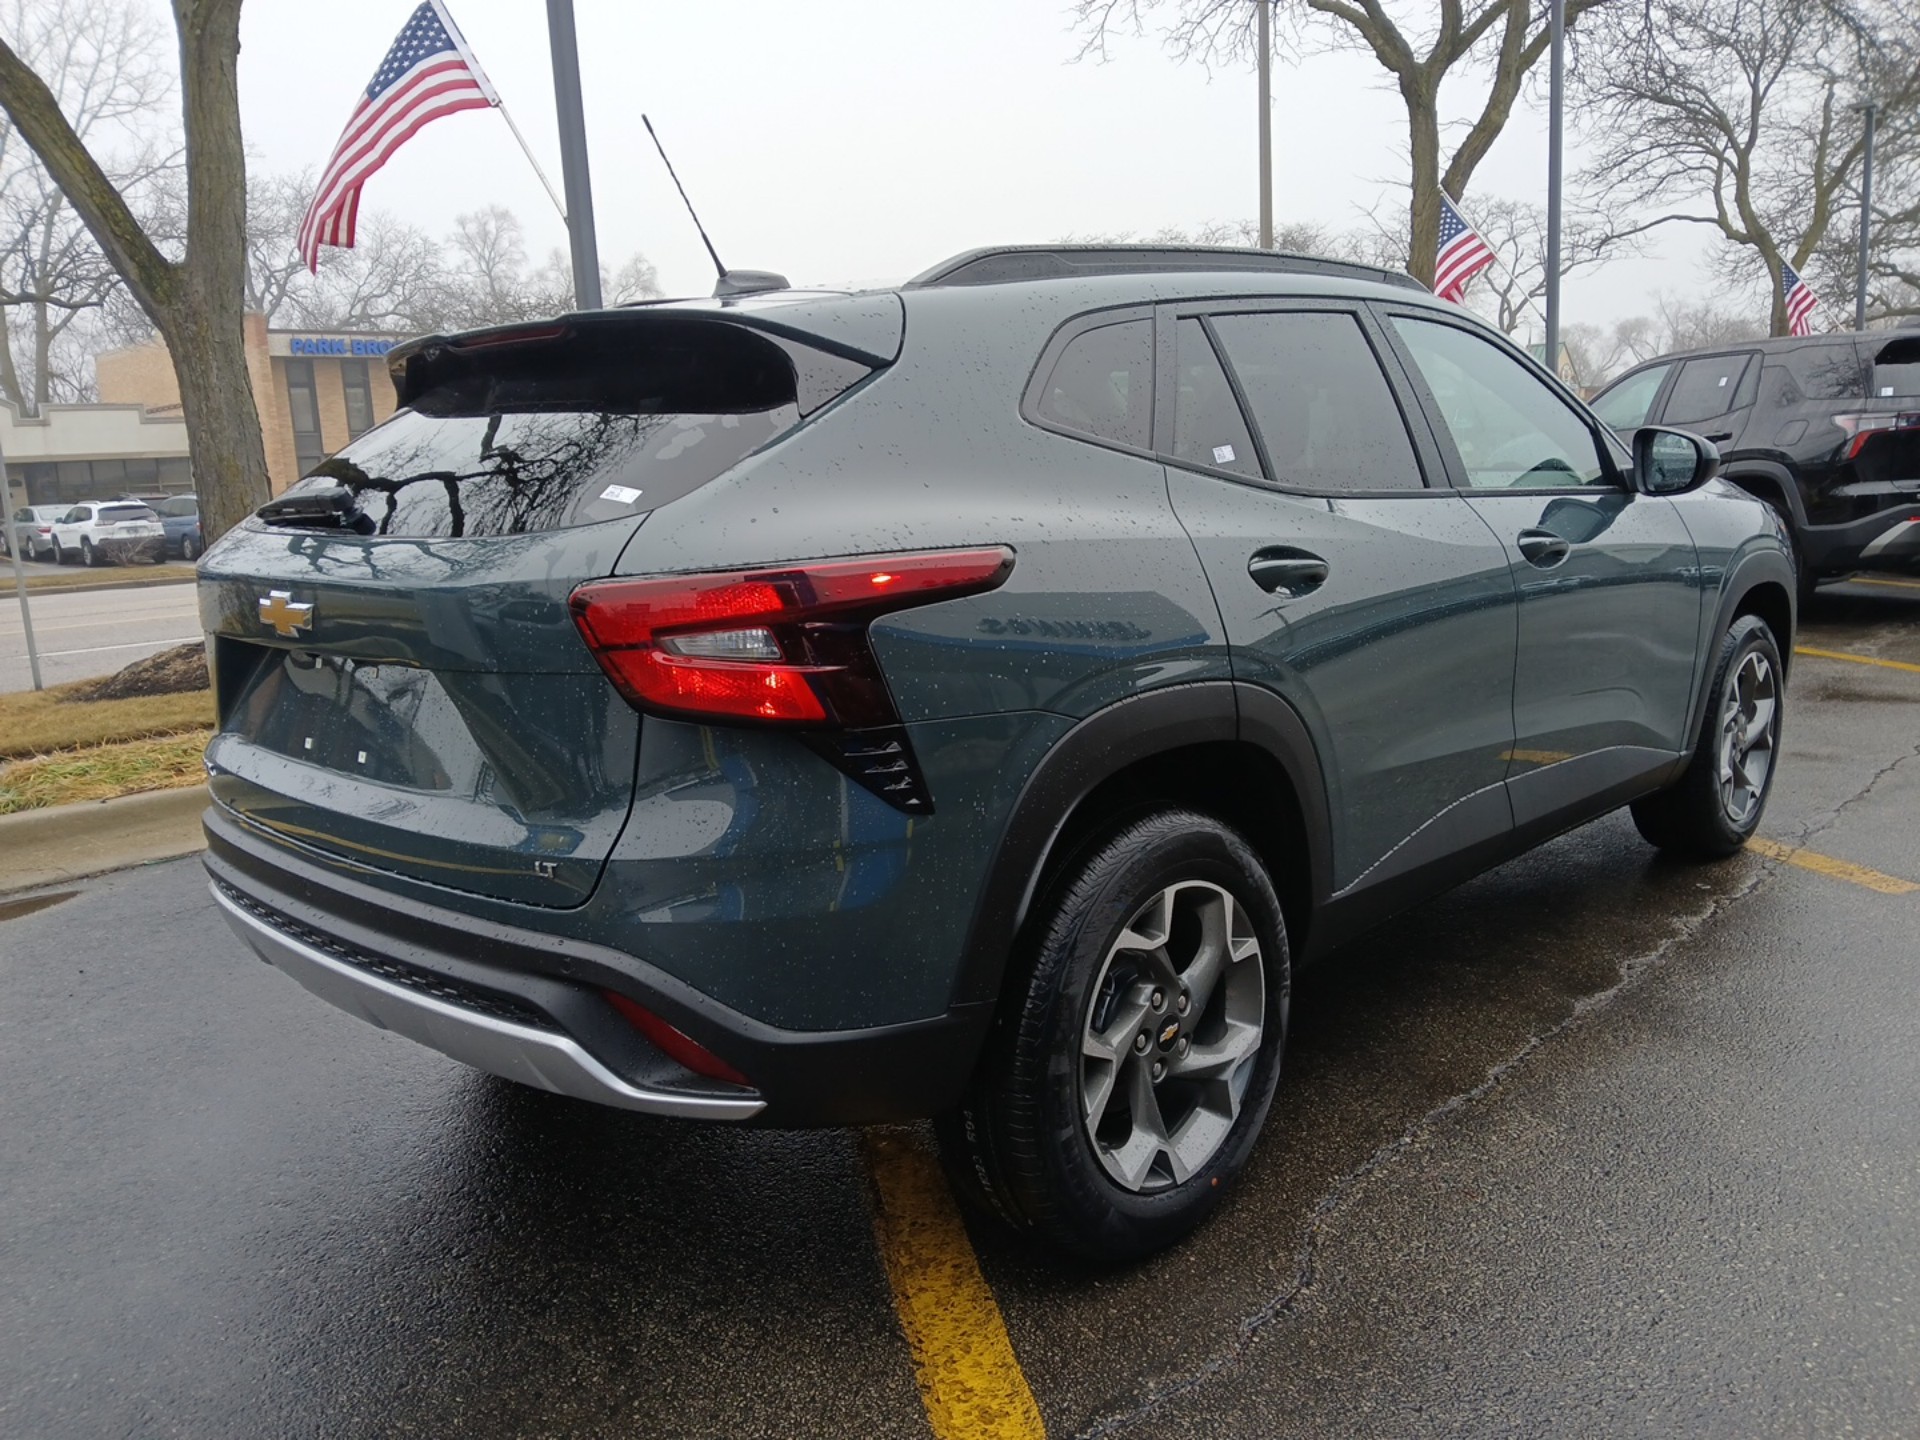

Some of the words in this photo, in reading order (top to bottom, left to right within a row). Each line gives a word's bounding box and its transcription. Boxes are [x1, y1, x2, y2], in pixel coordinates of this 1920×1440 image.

[290, 338, 347, 355] PARK
[351, 339, 399, 355] BRO
[534, 861, 558, 879] LT
